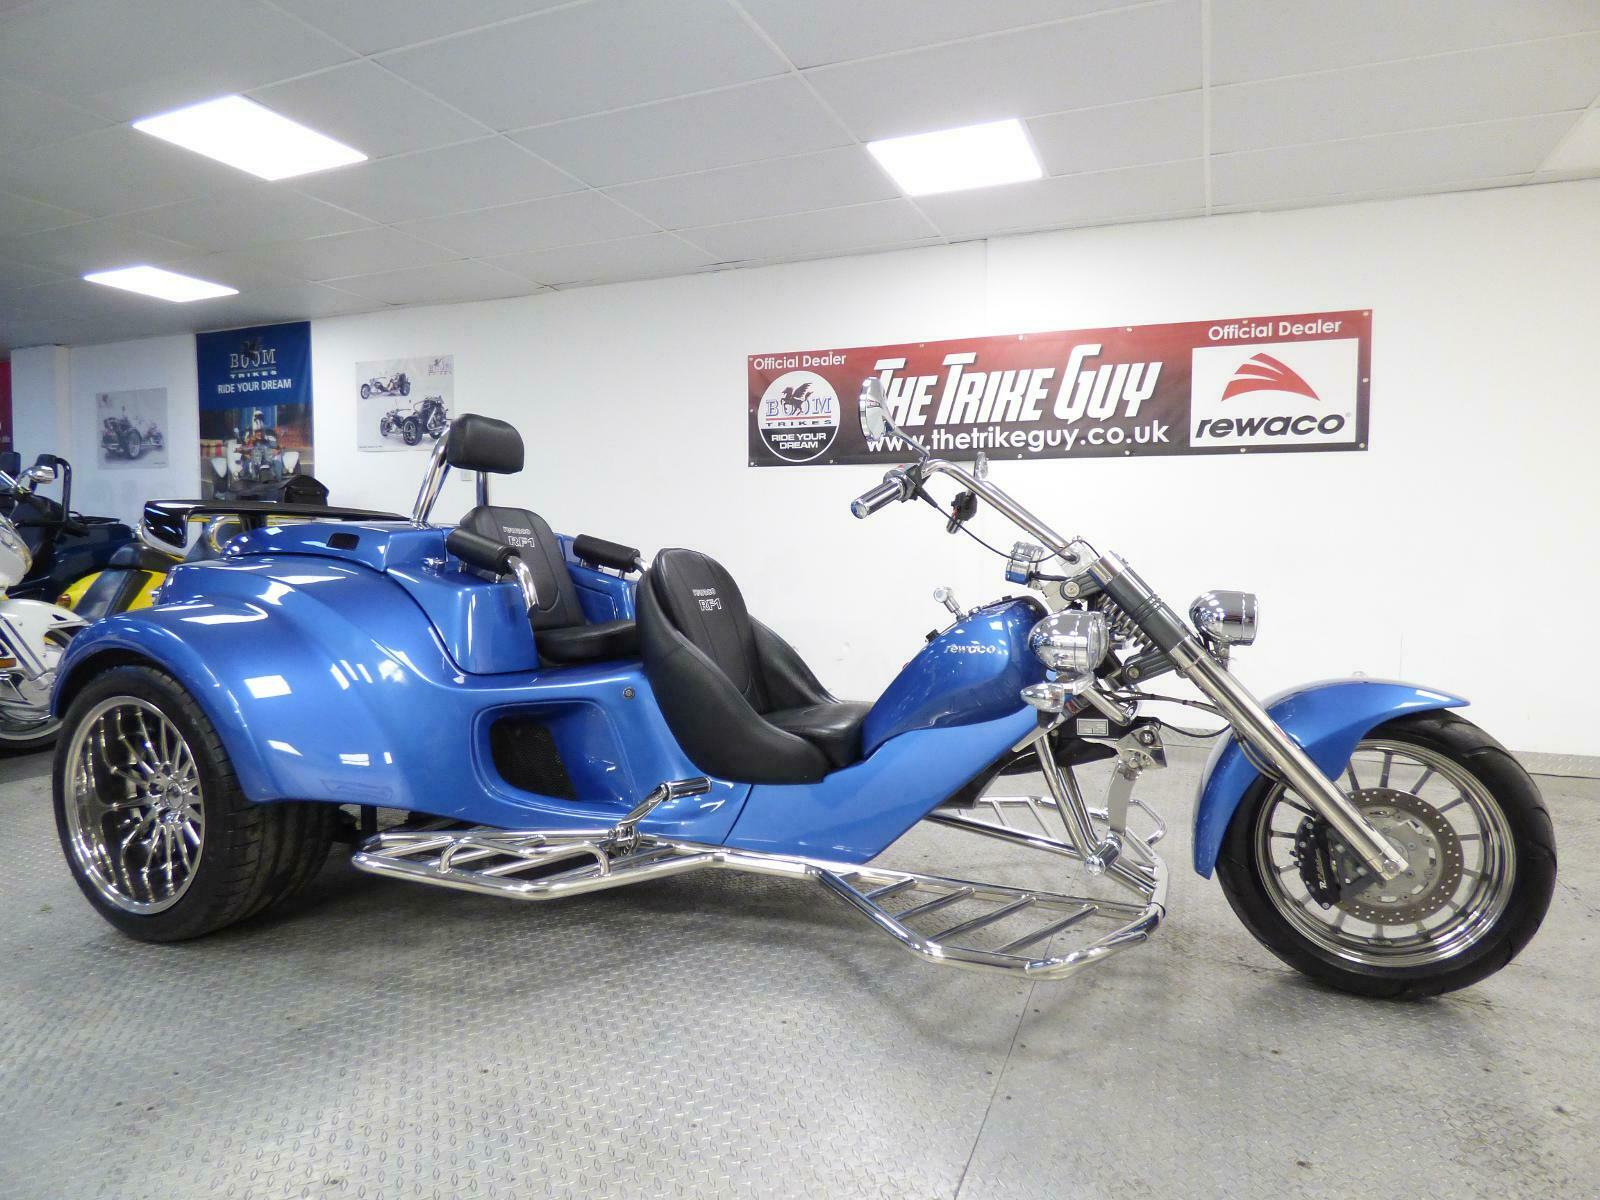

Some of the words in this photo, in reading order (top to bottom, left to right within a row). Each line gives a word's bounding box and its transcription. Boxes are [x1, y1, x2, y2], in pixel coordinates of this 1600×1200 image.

[1208, 322, 1273, 340] Official
[1278, 319, 1342, 336] Dealer
[753, 355, 799, 370] Official
[802, 353, 846, 367] Dealer
[218, 384, 235, 394] RIDE
[237, 382, 260, 392] YOUR
[261, 379, 291, 390] DREAM
[934, 352, 1056, 425] TRIKE
[1053, 343, 1163, 425] GUY
[765, 419, 832, 427] TRIKES
[1195, 413, 1345, 439] rewaco
[771, 434, 795, 442] RIDE
[796, 432, 827, 441] YOUR
[779, 441, 818, 450] DREAM
